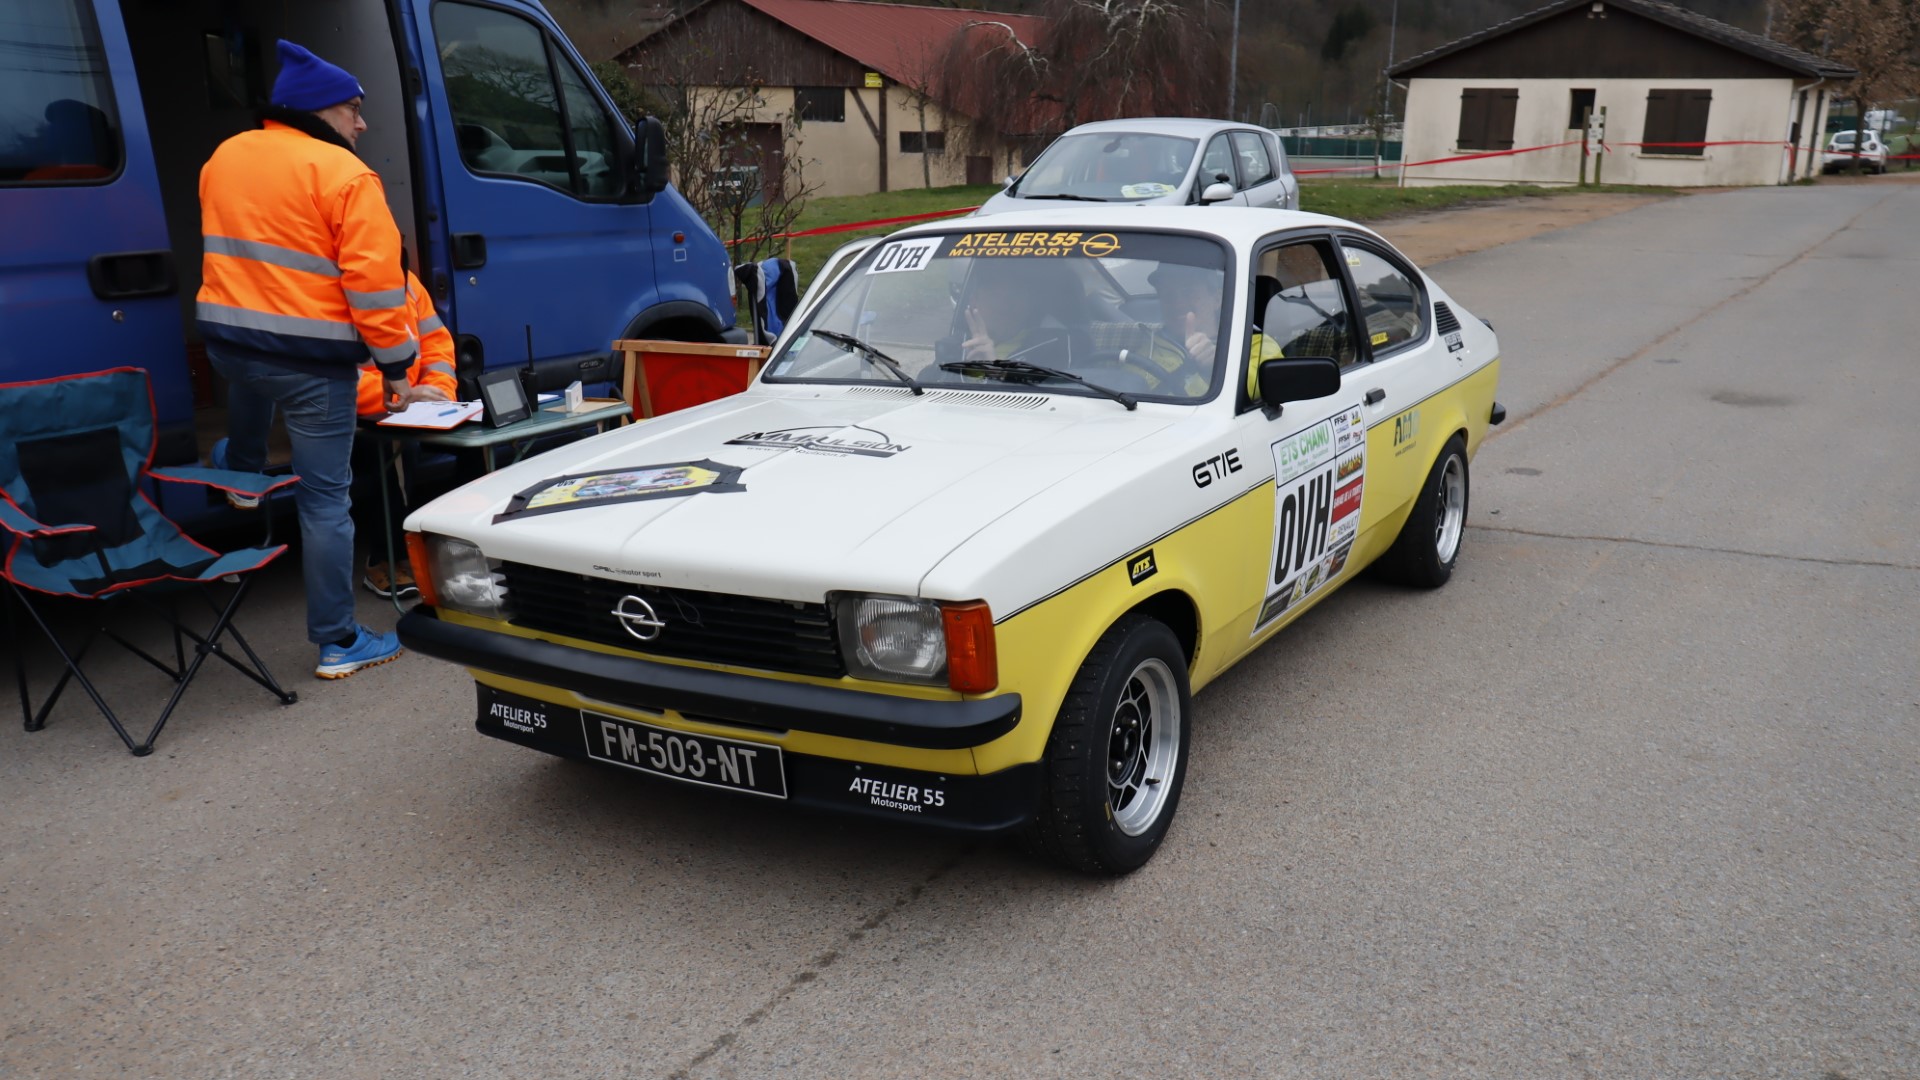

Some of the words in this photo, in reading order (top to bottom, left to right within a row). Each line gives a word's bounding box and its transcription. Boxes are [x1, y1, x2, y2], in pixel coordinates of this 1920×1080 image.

[949, 247, 1072, 257] MOTORSPORT
[1281, 439, 1299, 466] ETS
[1300, 423, 1329, 456] CHANU
[1192, 447, 1243, 489] GT/E
[1274, 469, 1333, 586] OVH
[490, 702, 531, 725] ATELIER
[533, 712, 547, 728] 55
[503, 719, 534, 734] Motorsport
[601, 720, 757, 787] FM-503-NT
[848, 777, 919, 802] ATELIER
[923, 788, 945, 807] 55
[870, 796, 922, 812] Motorsport
